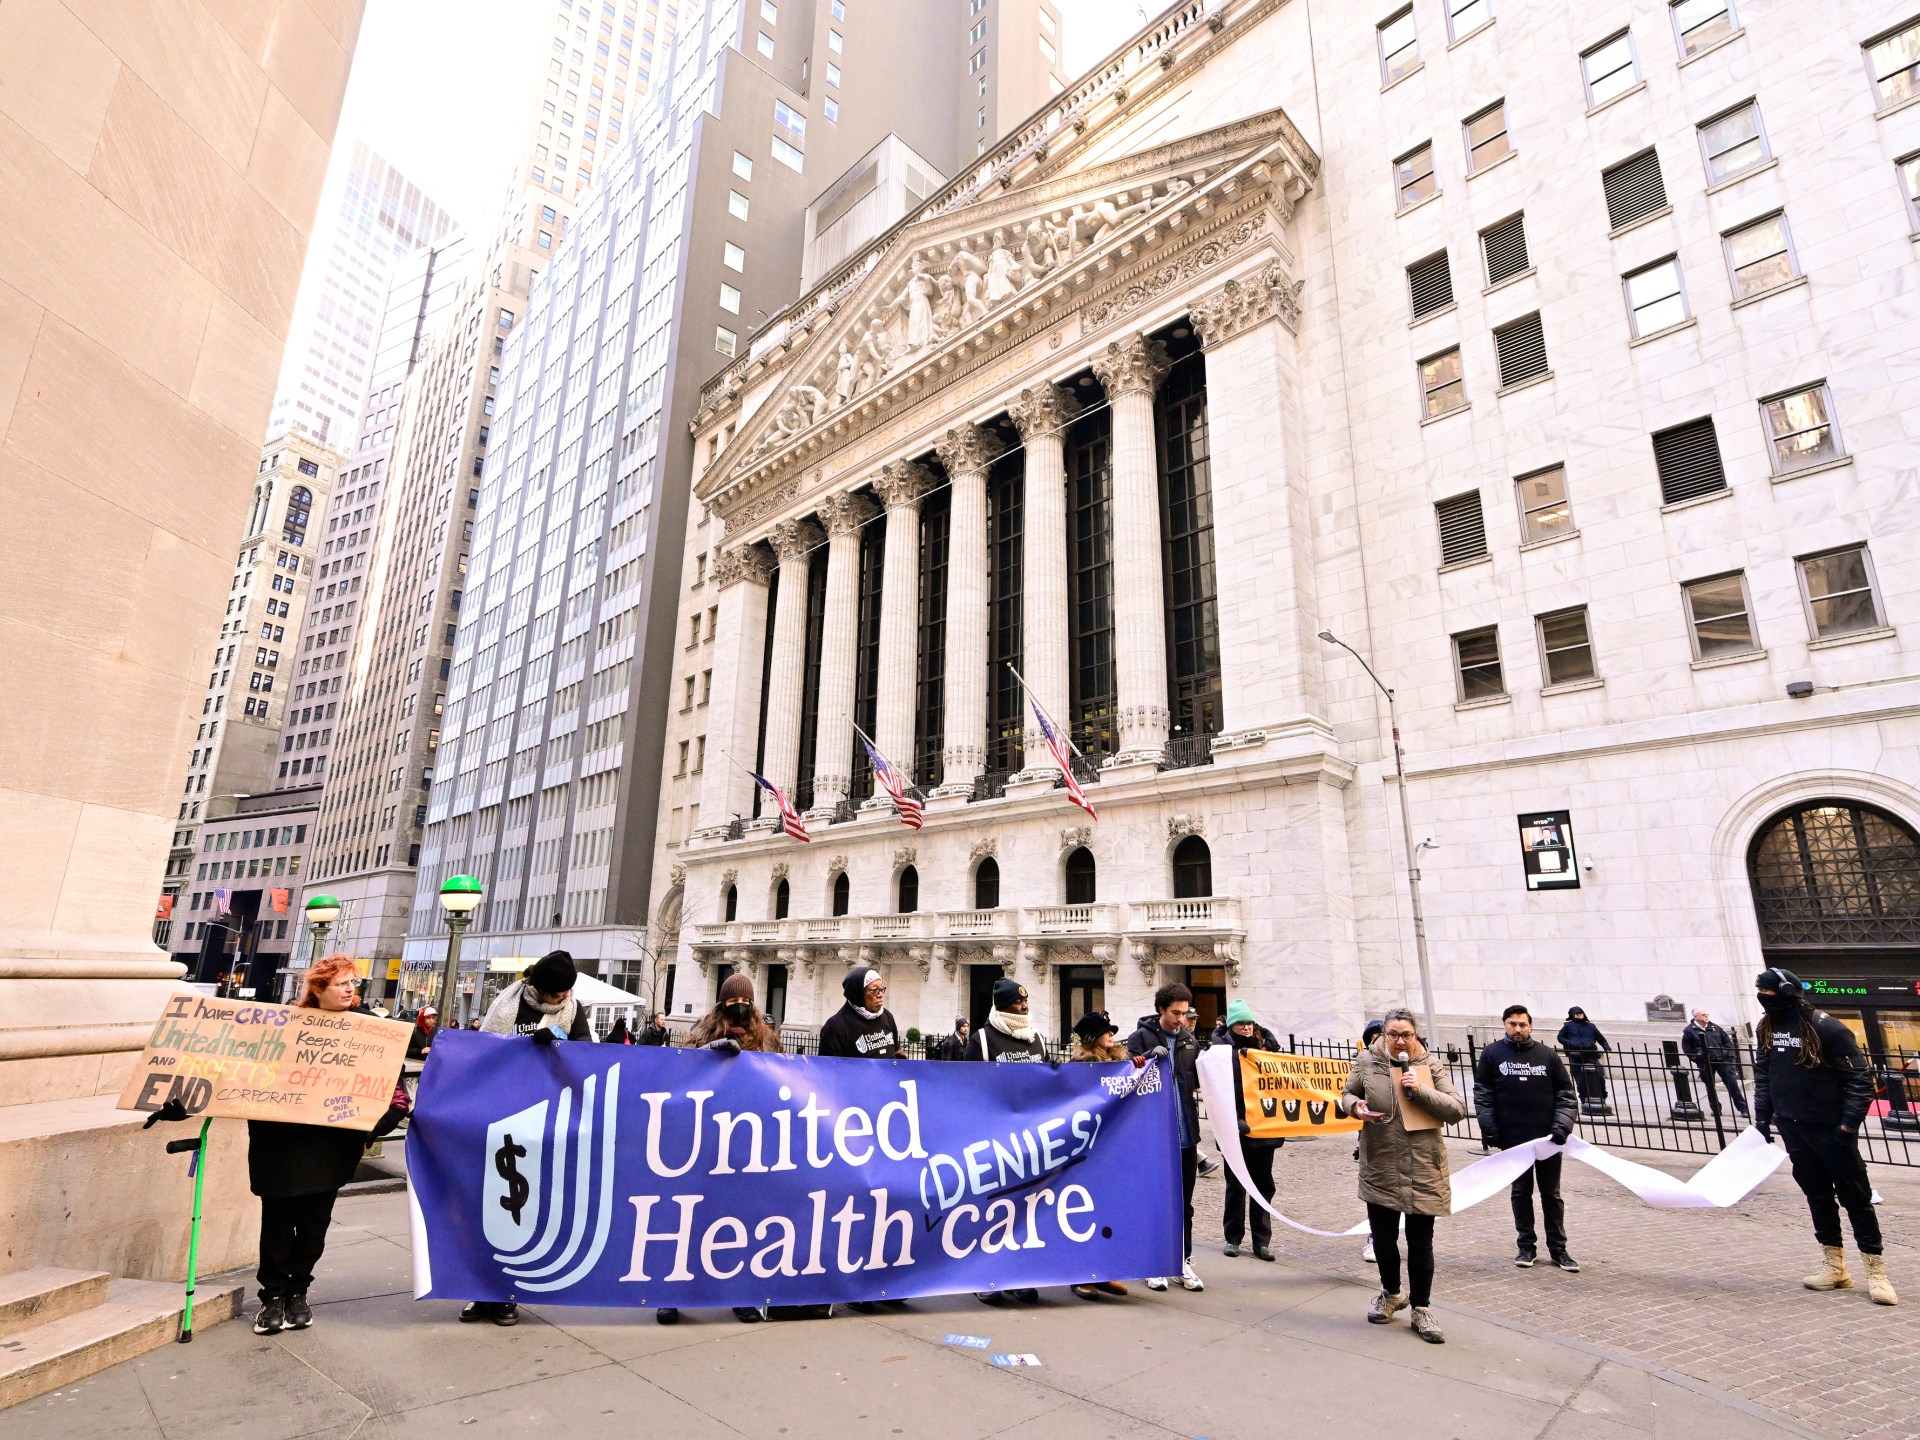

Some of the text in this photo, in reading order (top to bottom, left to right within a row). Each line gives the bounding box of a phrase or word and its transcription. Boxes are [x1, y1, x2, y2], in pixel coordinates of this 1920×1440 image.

[832, 349, 1033, 473] NEW YORK STOCK EXCHANGE
[166, 996, 407, 1042] I have CRPS the suicide disease
[518, 1021, 541, 1033] Unit
[296, 1030, 340, 1051] Keeps
[343, 1037, 385, 1058] denying
[865, 1029, 886, 1043] United
[1772, 1039, 1790, 1047] ealth
[296, 1049, 358, 1067] MY CARE
[1006, 1050, 1030, 1060] United
[1255, 1061, 1279, 1074] YOU
[1280, 1061, 1309, 1074] MAKE
[148, 1056, 176, 1066] AND
[326, 1076, 348, 1092] my
[351, 1074, 391, 1099] PAIN
[1258, 1076, 1309, 1091] DENYING
[1310, 1077, 1332, 1091] OUR
[134, 1073, 307, 1114] END CORPORATE
[1136, 1081, 1162, 1096] COST!
[227, 1101, 284, 1116] GREED
[324, 1096, 354, 1107] COVER
[641, 1080, 928, 1178] United
[920, 1110, 1102, 1211] (DENIES)
[618, 1188, 915, 1283] Health
